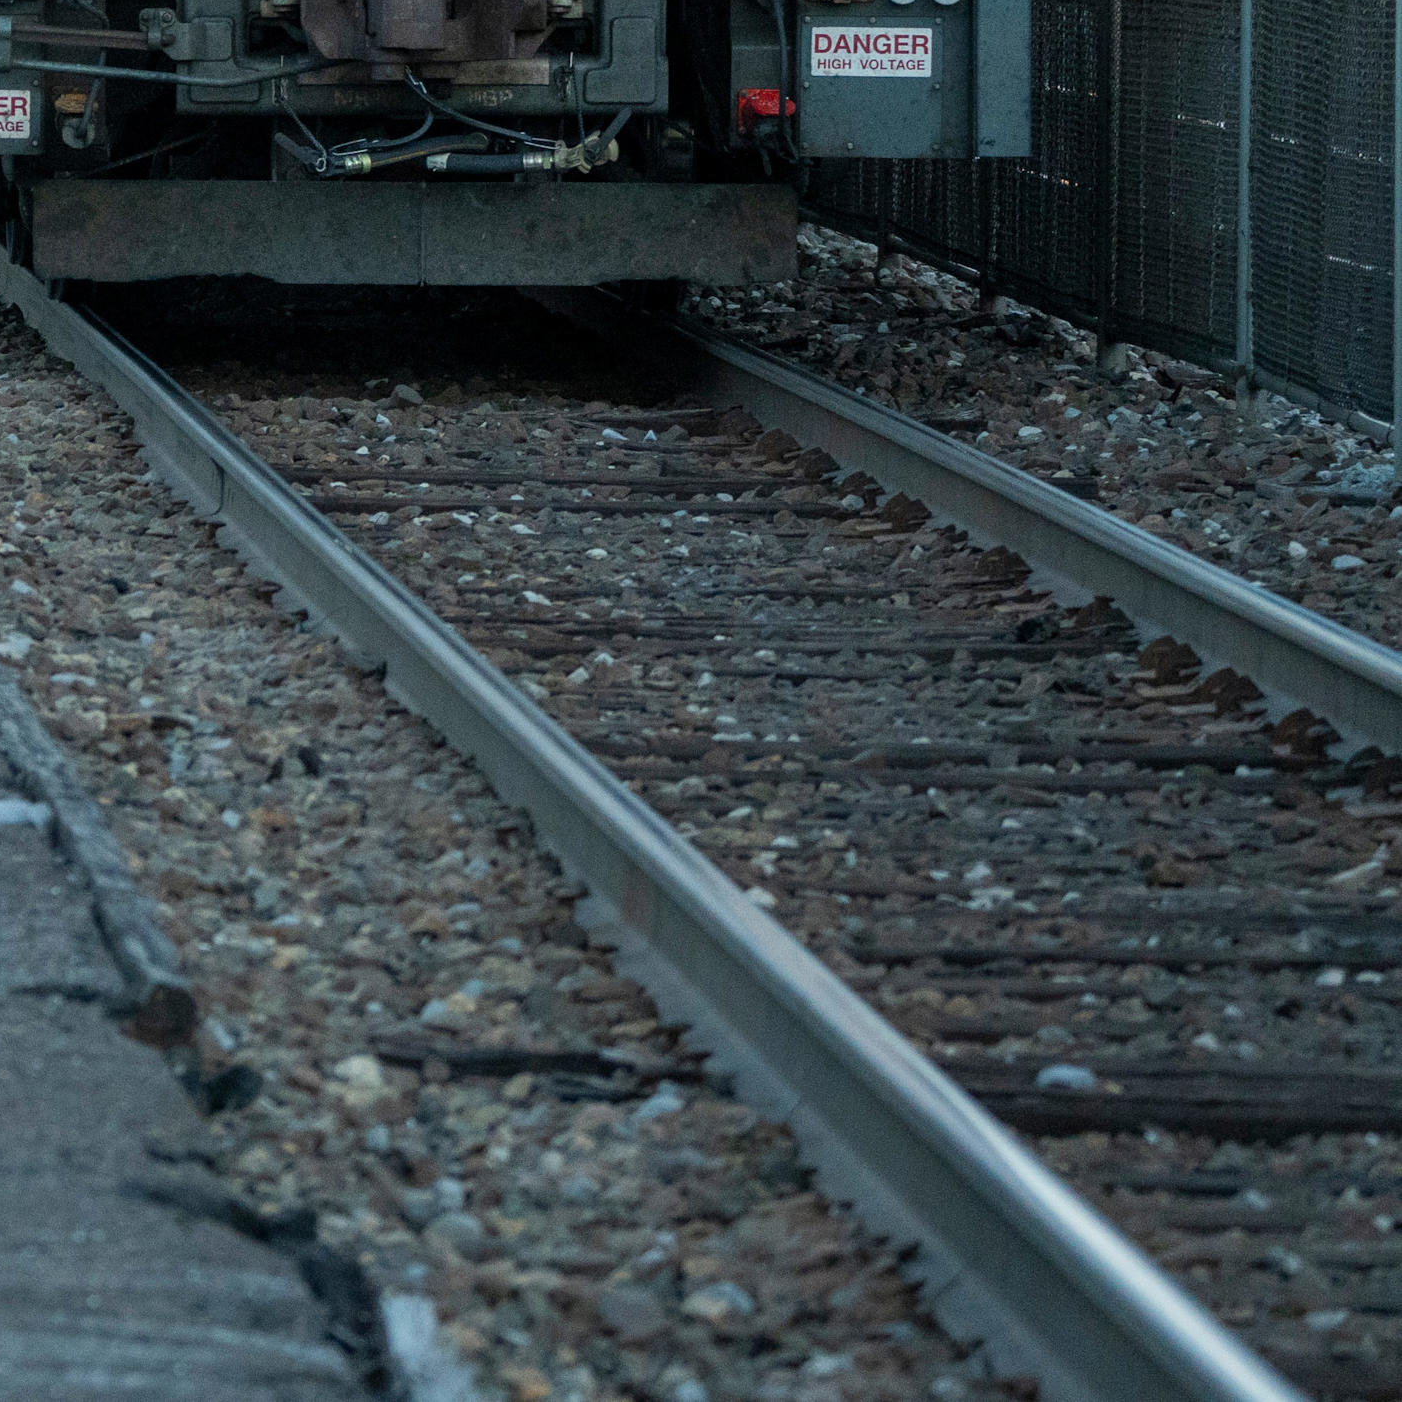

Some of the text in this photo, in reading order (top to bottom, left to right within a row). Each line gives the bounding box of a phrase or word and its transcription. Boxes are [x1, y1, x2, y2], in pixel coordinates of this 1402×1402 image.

[814, 34, 929, 55] DANGER
[817, 59, 925, 70] HIGH VOLTAGE
